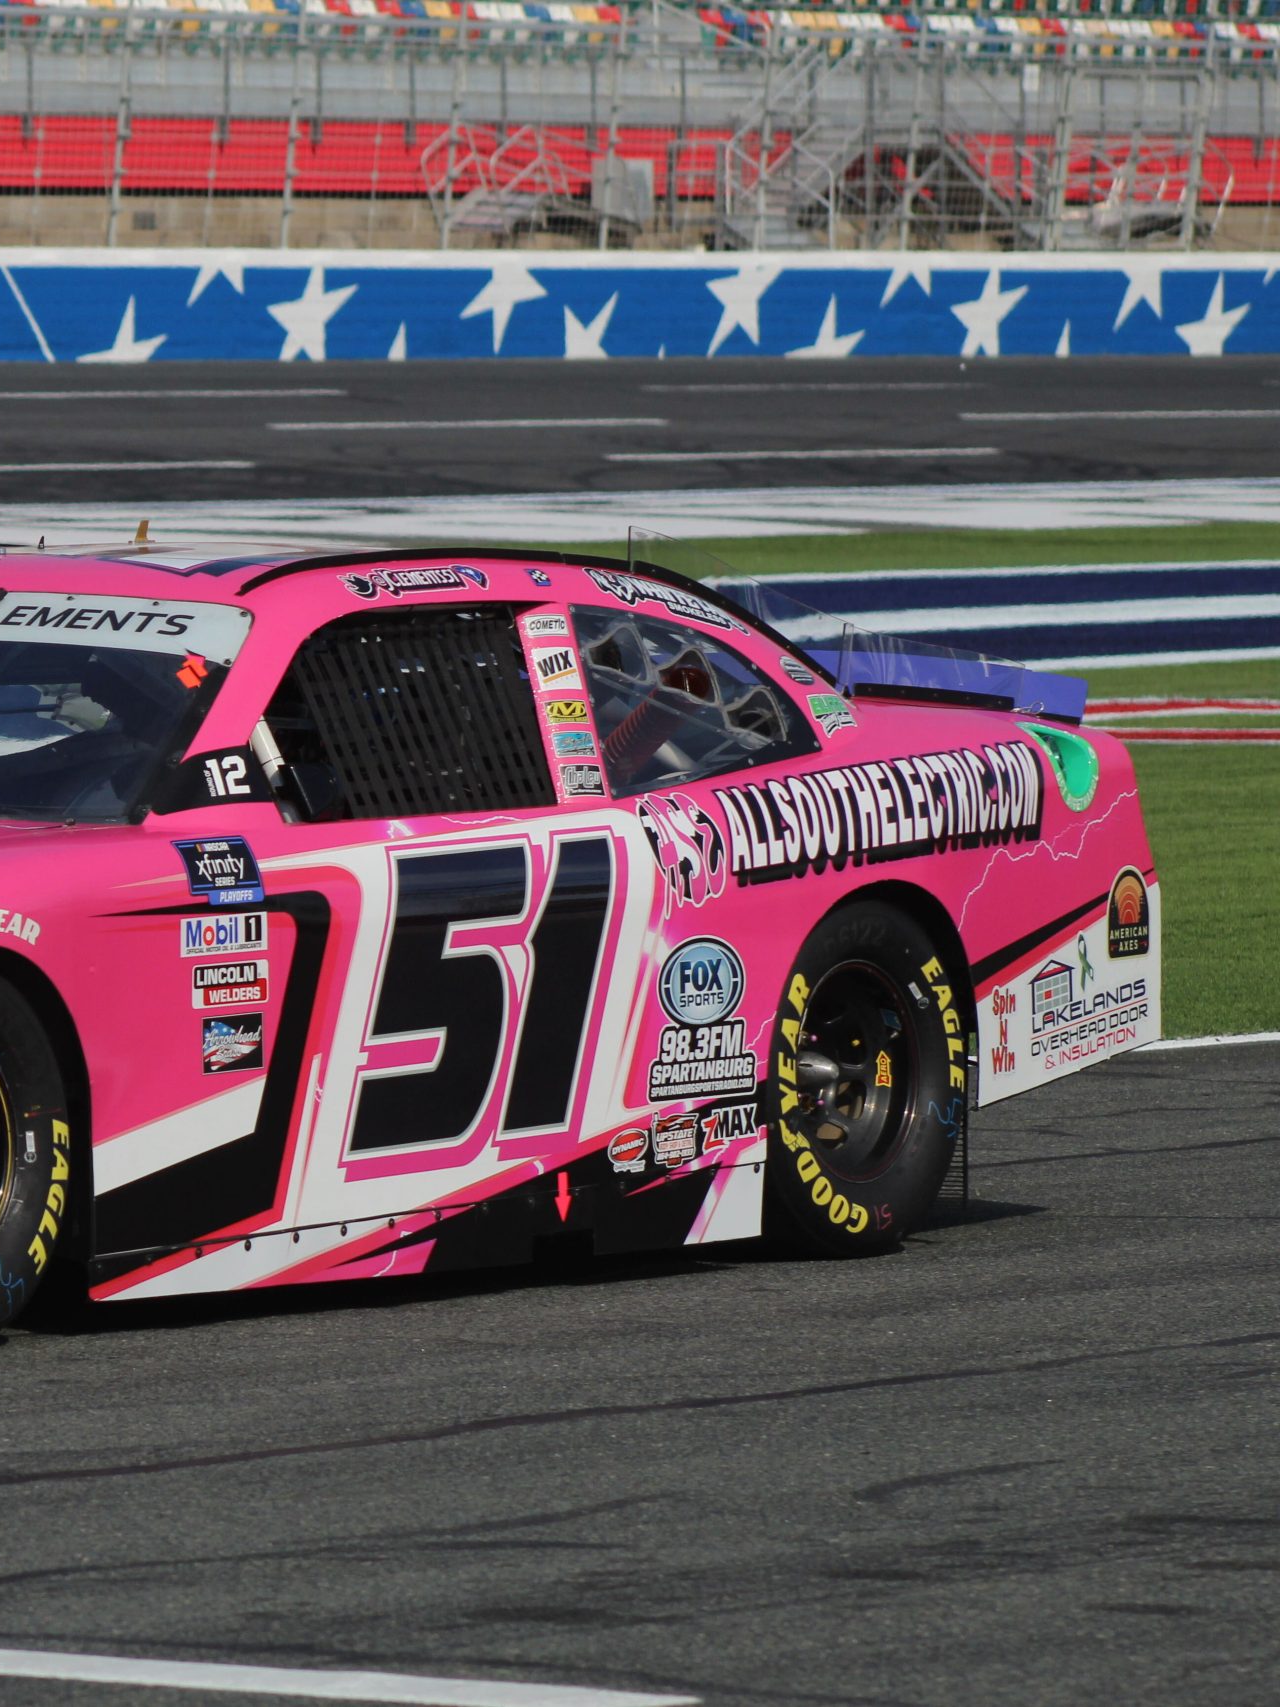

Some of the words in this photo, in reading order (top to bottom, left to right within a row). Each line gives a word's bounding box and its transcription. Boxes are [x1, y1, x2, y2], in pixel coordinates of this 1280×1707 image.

[536, 650, 573, 677] WIX
[205, 755, 251, 796] 12
[716, 742, 1040, 874] ALLSOUTHELECTRIC.COM
[195, 854, 244, 881] xfinity
[214, 877, 236, 887] SERIES
[219, 890, 254, 902] PLAYOFFS
[186, 917, 239, 948] Mobil
[1109, 925, 1148, 940] AMERICAN
[1118, 939, 1139, 952] AXES
[196, 965, 255, 987] LINCOLN
[679, 958, 723, 993] FOX
[209, 986, 261, 1003] WELDERS
[342, 832, 618, 1160] 51
[679, 991, 724, 1008] SPORTS
[991, 988, 1016, 1020] Spin
[1032, 978, 1146, 1034] LAKELANDS
[921, 955, 965, 1092] EAGLE
[999, 1020, 1008, 1046] N
[1031, 1017, 1107, 1057] OVERHEAD
[1109, 1003, 1148, 1029] DOOR
[660, 1022, 742, 1063] 98.3FM
[1045, 1053, 1057, 1070] &
[1059, 1025, 1136, 1065] INSULATION
[651, 1056, 753, 1085] SPARTANBURG
[991, 1046, 1015, 1075] Win
[611, 1137, 645, 1155] DYNAMIC
[656, 1129, 693, 1142] UPSTATE
[28, 1118, 70, 1276] EAGLE
